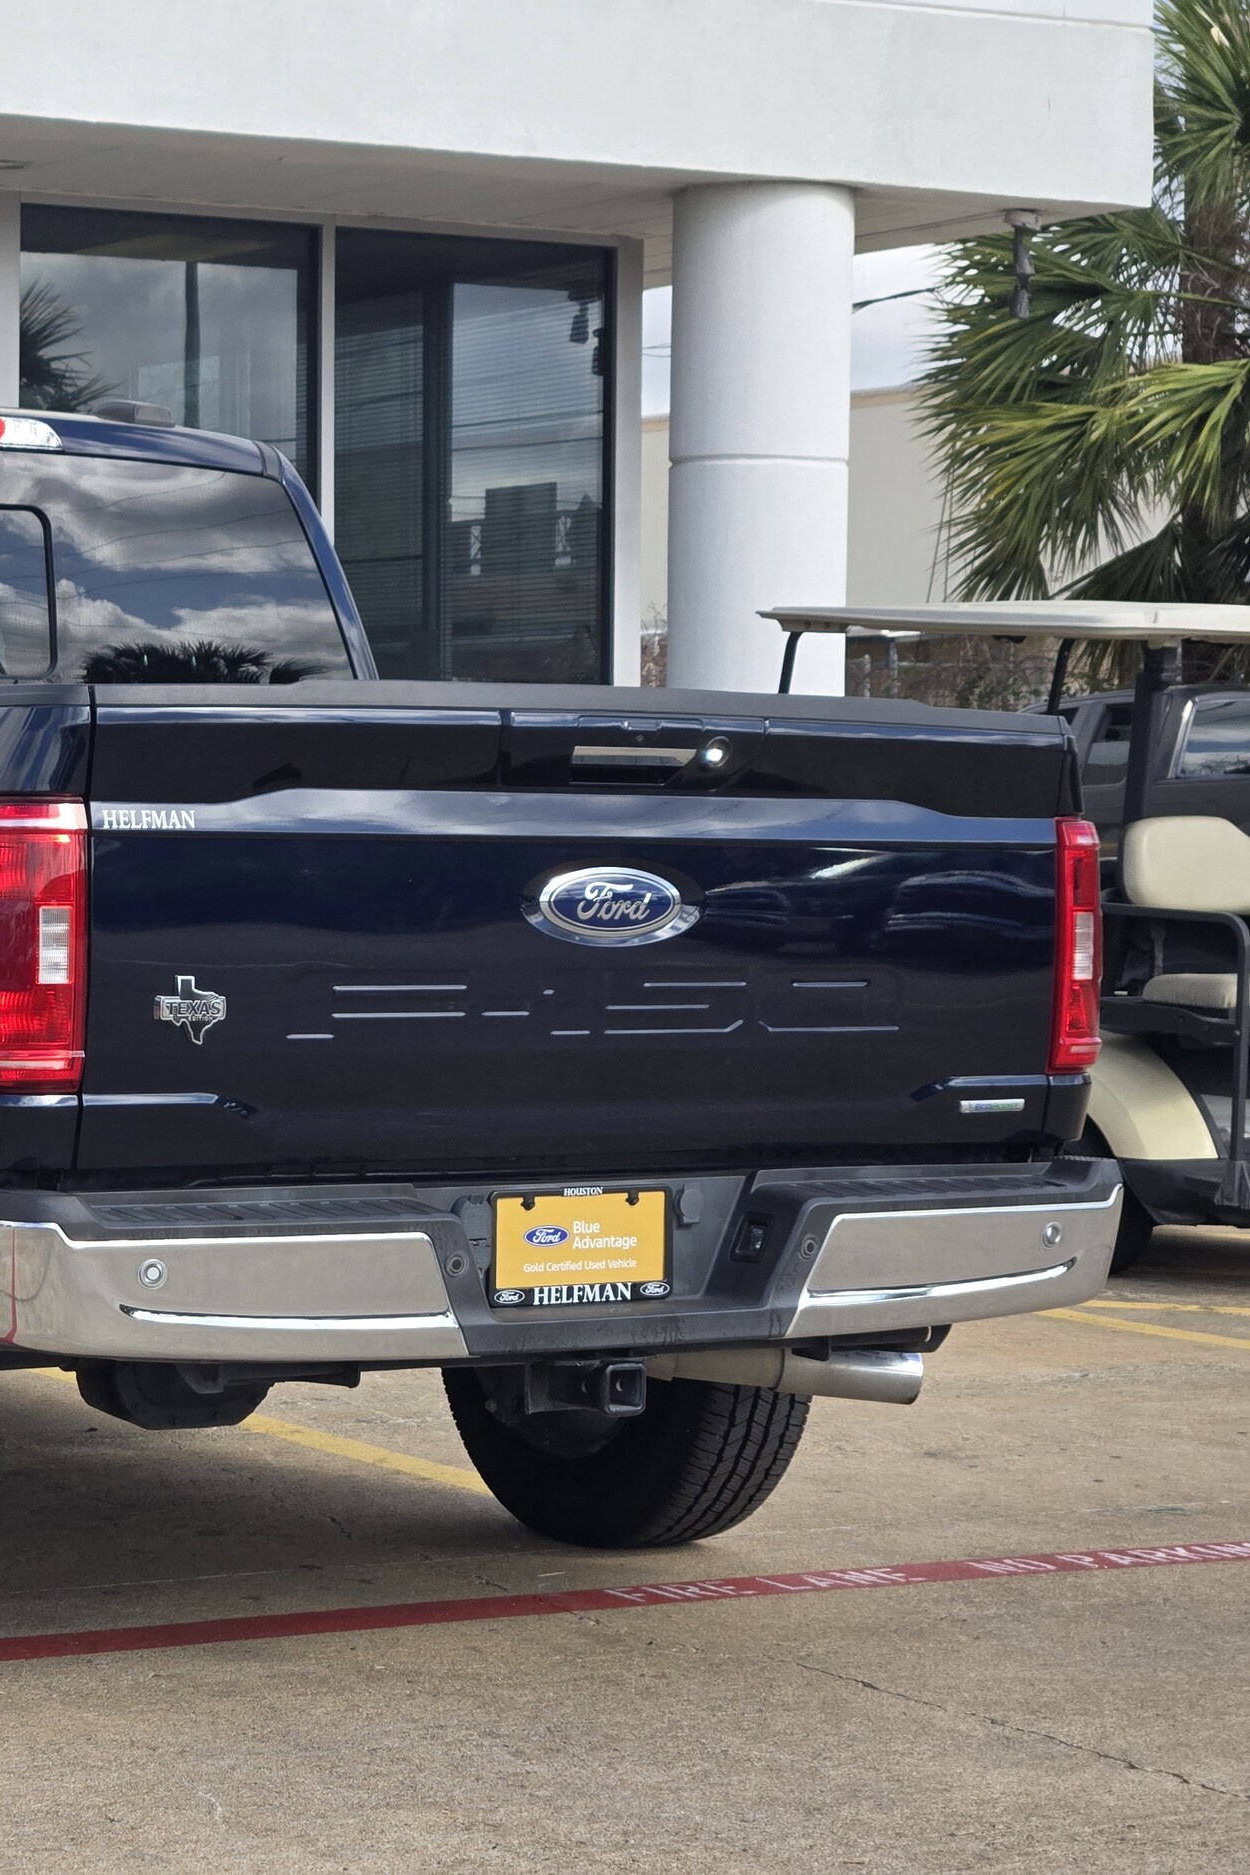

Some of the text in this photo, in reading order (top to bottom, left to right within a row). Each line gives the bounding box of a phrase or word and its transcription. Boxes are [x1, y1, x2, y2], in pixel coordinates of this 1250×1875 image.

[102, 810, 196, 829] HELFMAN
[577, 882, 652, 920] Ford
[165, 1000, 221, 1015] TEXAS
[563, 1187, 604, 1196] HOUSTON
[573, 1221, 600, 1233] Blue
[532, 1228, 561, 1244] Ford
[573, 1235, 638, 1250] Advantage
[523, 1258, 638, 1273] Gold Certified Used Vehicle
[532, 1282, 632, 1305] HELFMAN
[603, 1542, 1250, 1602] FIRE LANE NO PARKIN
